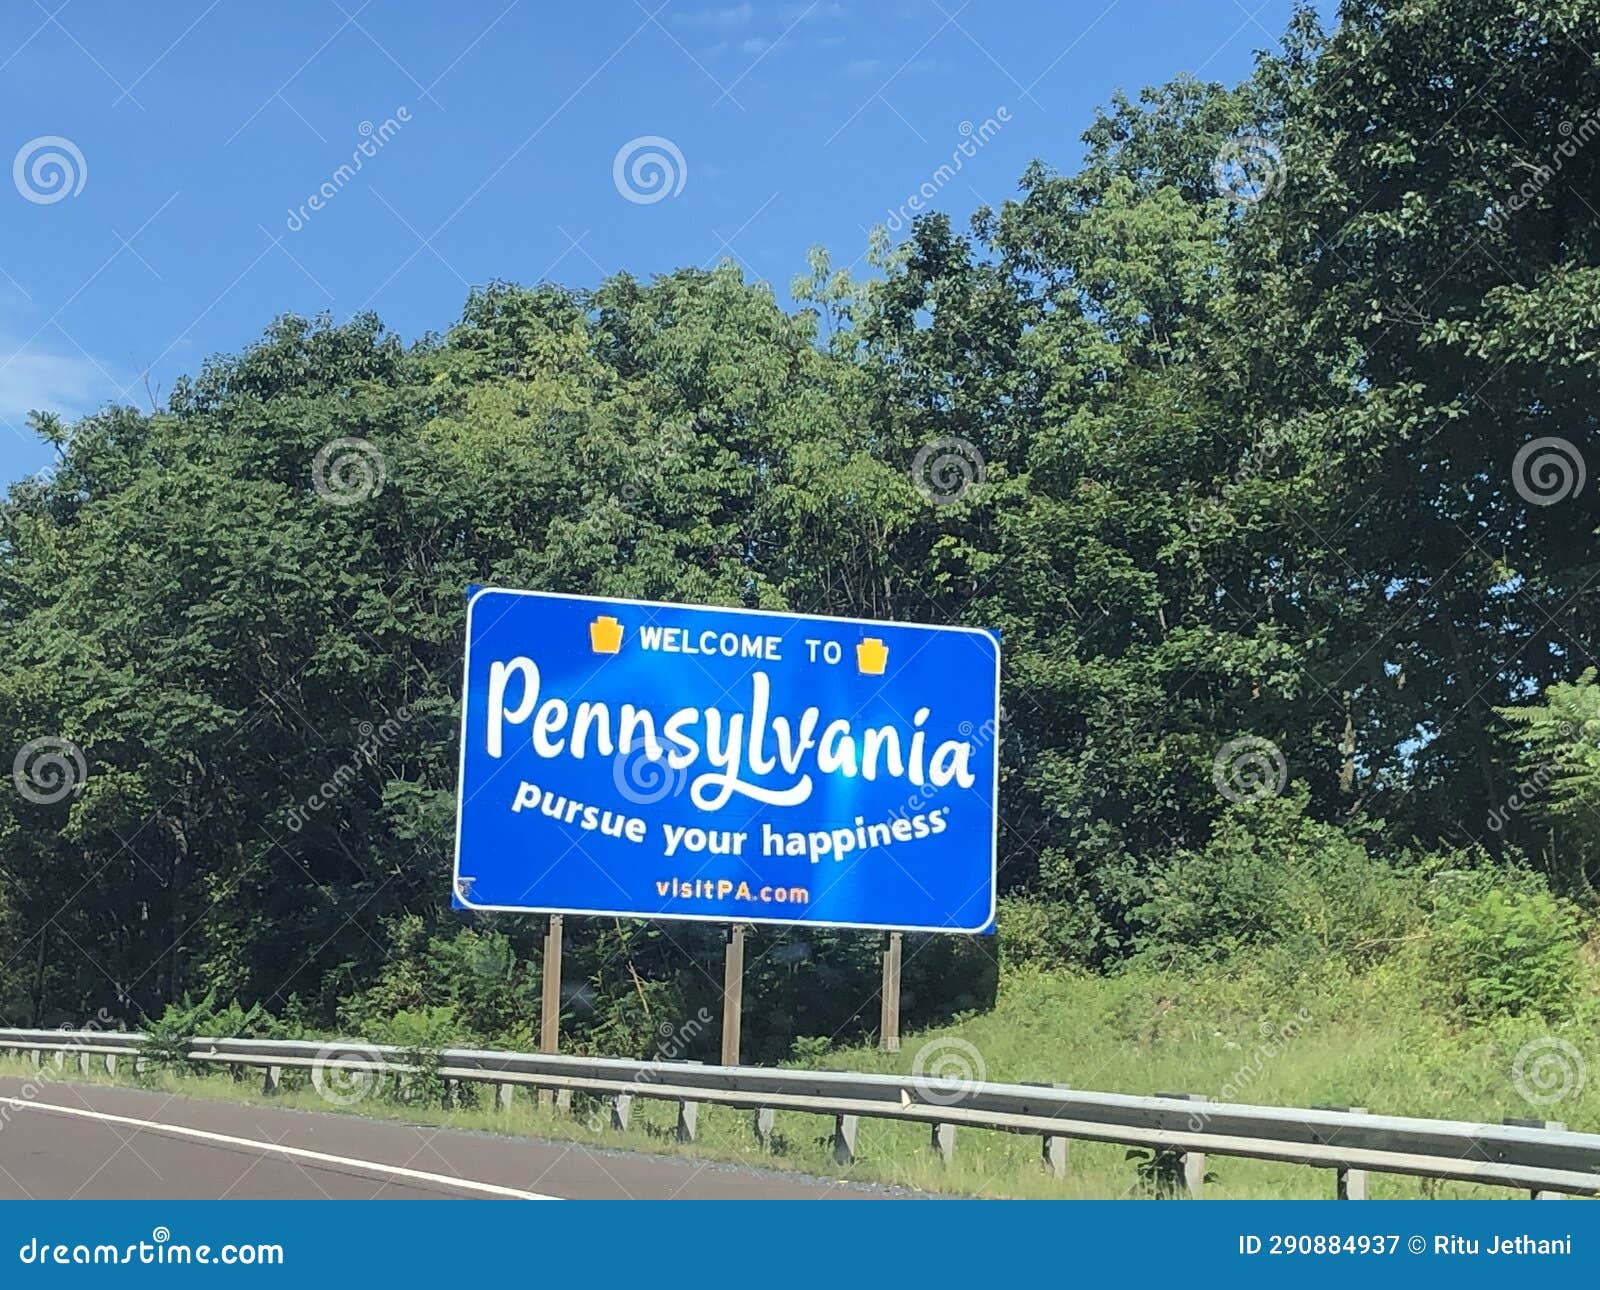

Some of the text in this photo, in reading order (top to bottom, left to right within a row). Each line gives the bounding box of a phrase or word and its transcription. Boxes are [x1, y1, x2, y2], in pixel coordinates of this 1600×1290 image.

[639, 625, 842, 665] WELCOME TO
[487, 655, 976, 811] Pennsylvania
[511, 780, 948, 864] pursue your happiness
[655, 877, 810, 905] visitPA.com
